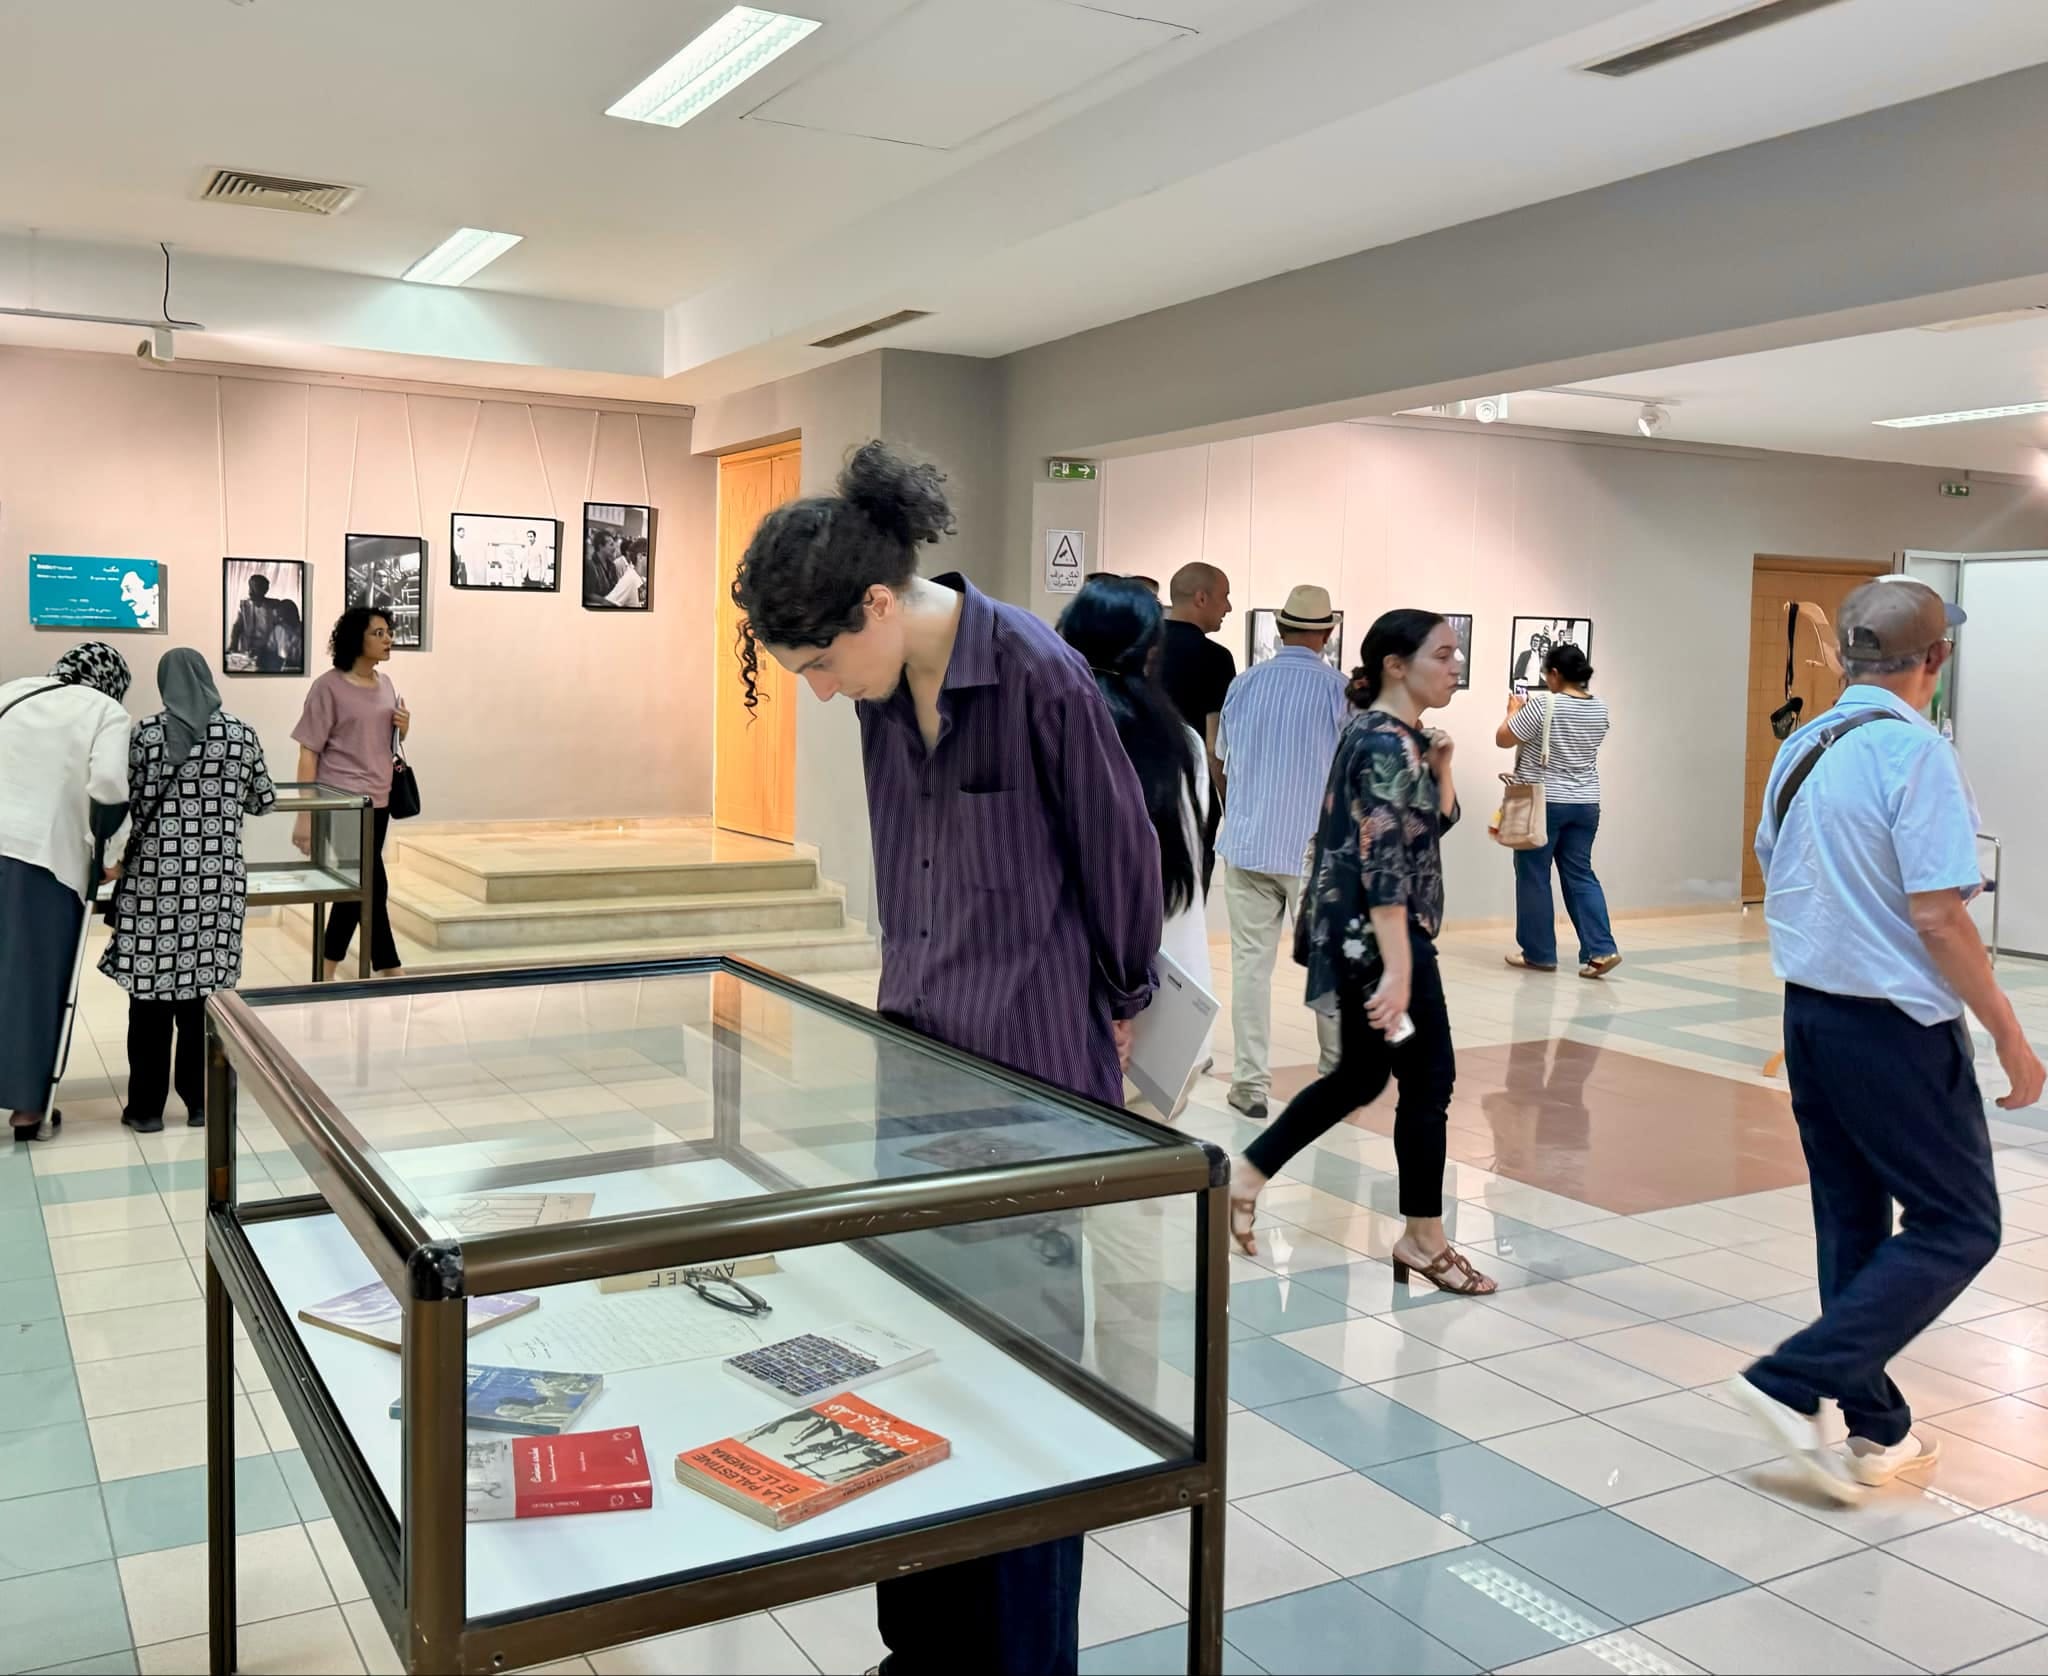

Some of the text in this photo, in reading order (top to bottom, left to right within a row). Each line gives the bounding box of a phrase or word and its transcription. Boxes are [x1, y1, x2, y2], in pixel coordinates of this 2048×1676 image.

[692, 1453, 761, 1492] PALESTINE
[711, 1447, 800, 1494] ET LE CINEMA
[762, 1488, 783, 1500] LA
